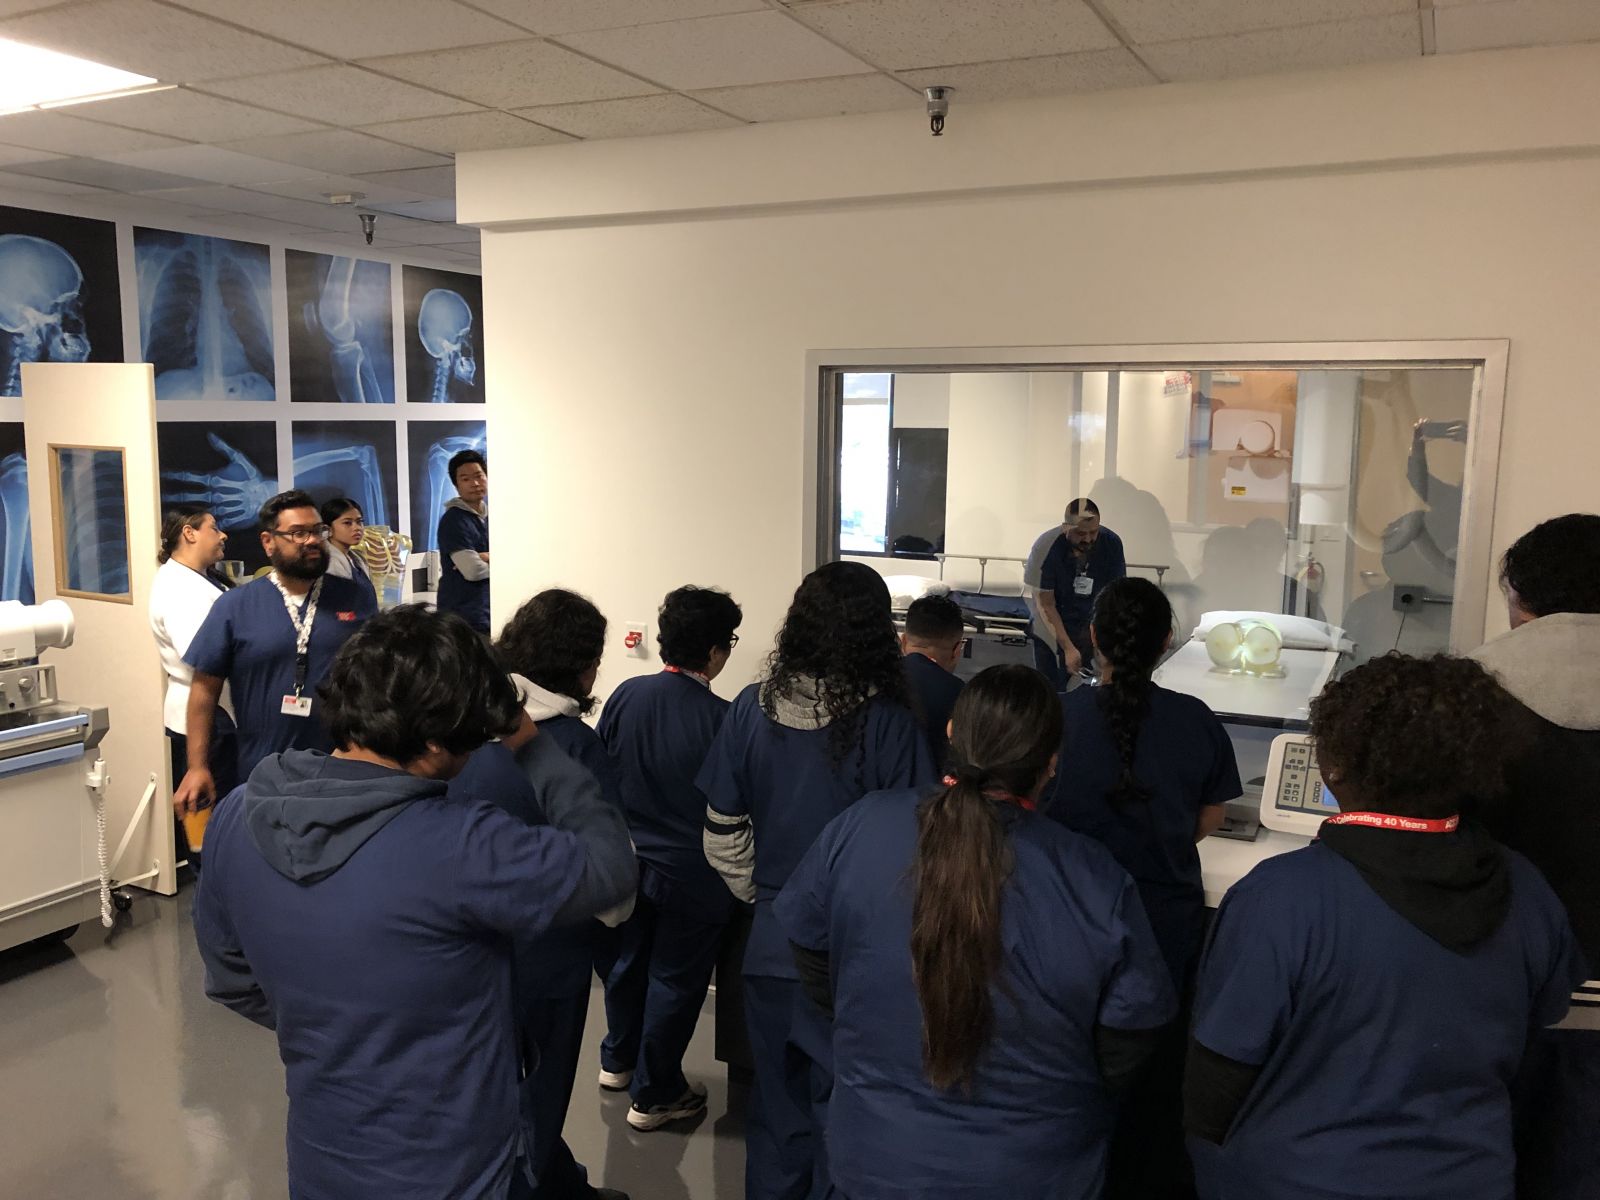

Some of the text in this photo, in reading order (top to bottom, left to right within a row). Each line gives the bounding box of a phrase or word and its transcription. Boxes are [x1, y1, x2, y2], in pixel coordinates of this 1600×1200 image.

[1336, 814, 1382, 826] Celebrating
[1383, 817, 1397, 826] 40
[1399, 818, 1428, 830] Years
